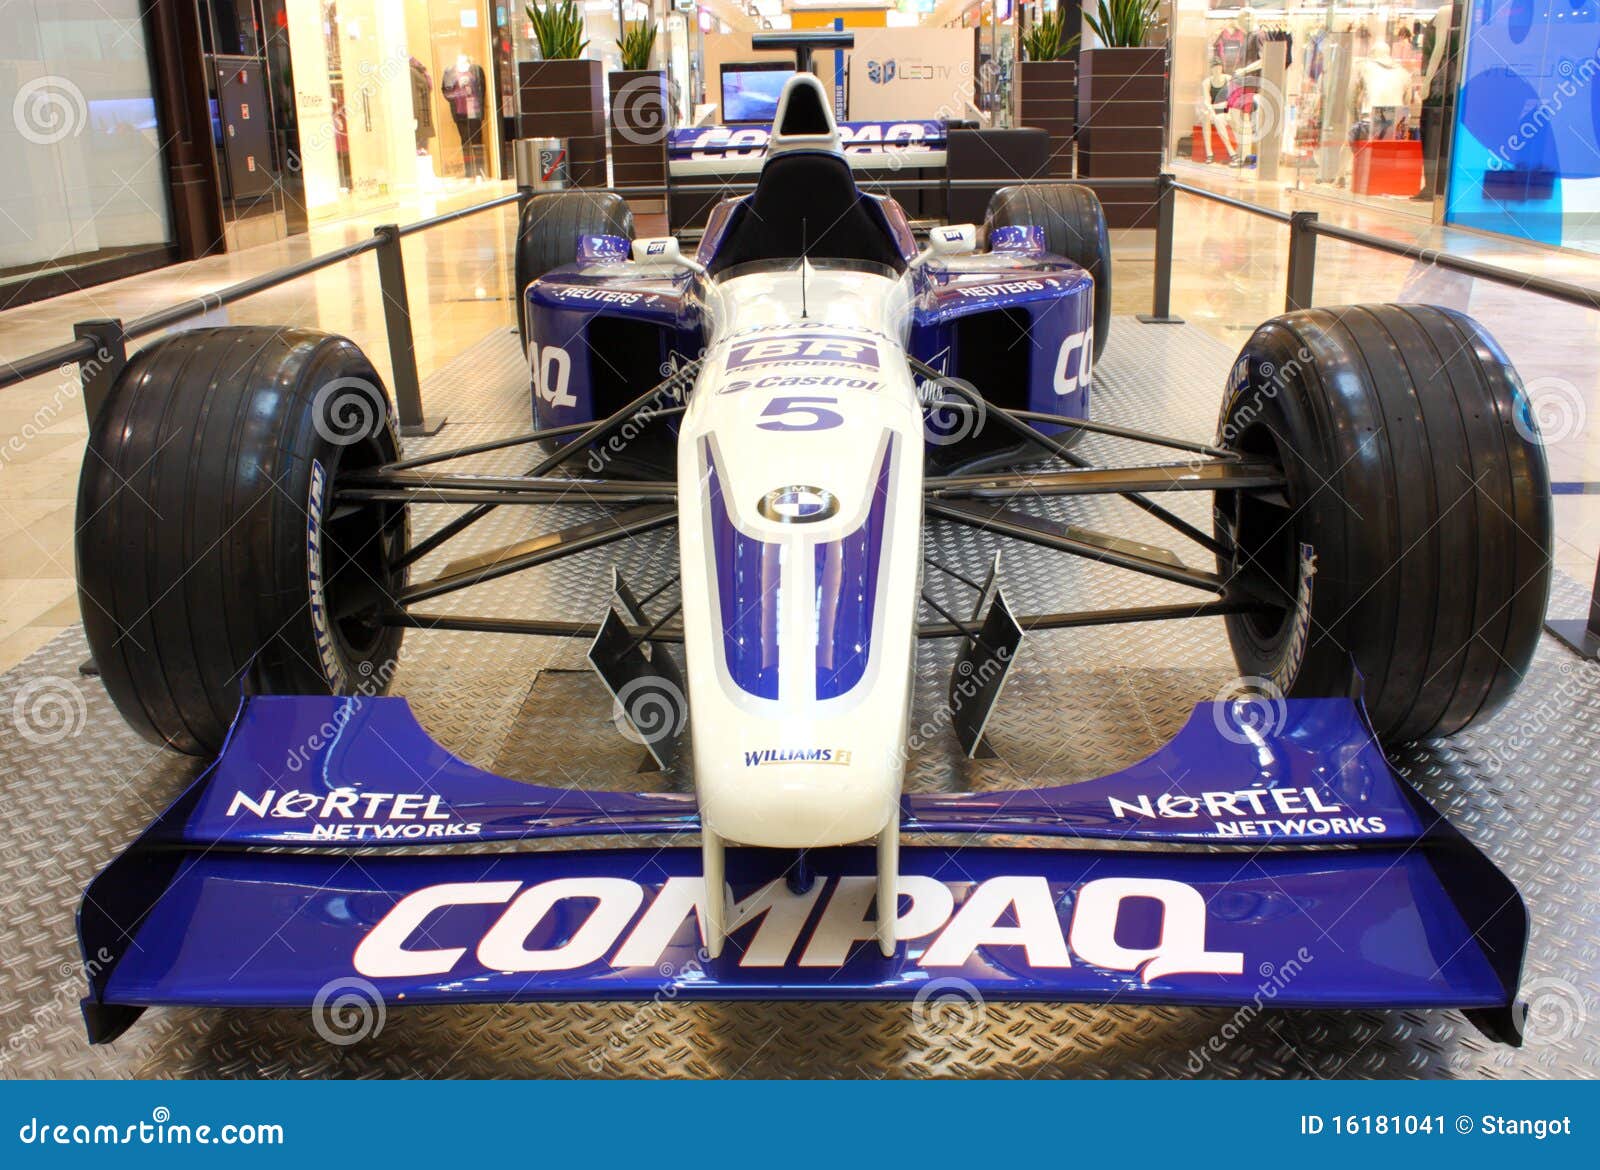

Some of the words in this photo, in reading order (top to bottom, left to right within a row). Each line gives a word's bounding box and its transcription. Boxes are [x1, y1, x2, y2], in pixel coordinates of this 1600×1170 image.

[836, 85, 844, 121] AMSUNG
[691, 123, 931, 160] COAQ
[560, 286, 643, 304] REUTERS
[957, 279, 1045, 298] REUTERS
[740, 338, 866, 363] BR
[724, 359, 880, 377] PETROBRAS
[754, 375, 882, 391] Castrol
[755, 396, 845, 432] 5
[744, 748, 832, 767] WILLIAMS
[225, 789, 451, 820] NORTEL
[1107, 786, 1342, 820] NORTEL
[311, 822, 481, 839] NETWORKS
[1214, 816, 1386, 837] NETWORKS
[352, 875, 1244, 984] COMPAQ
